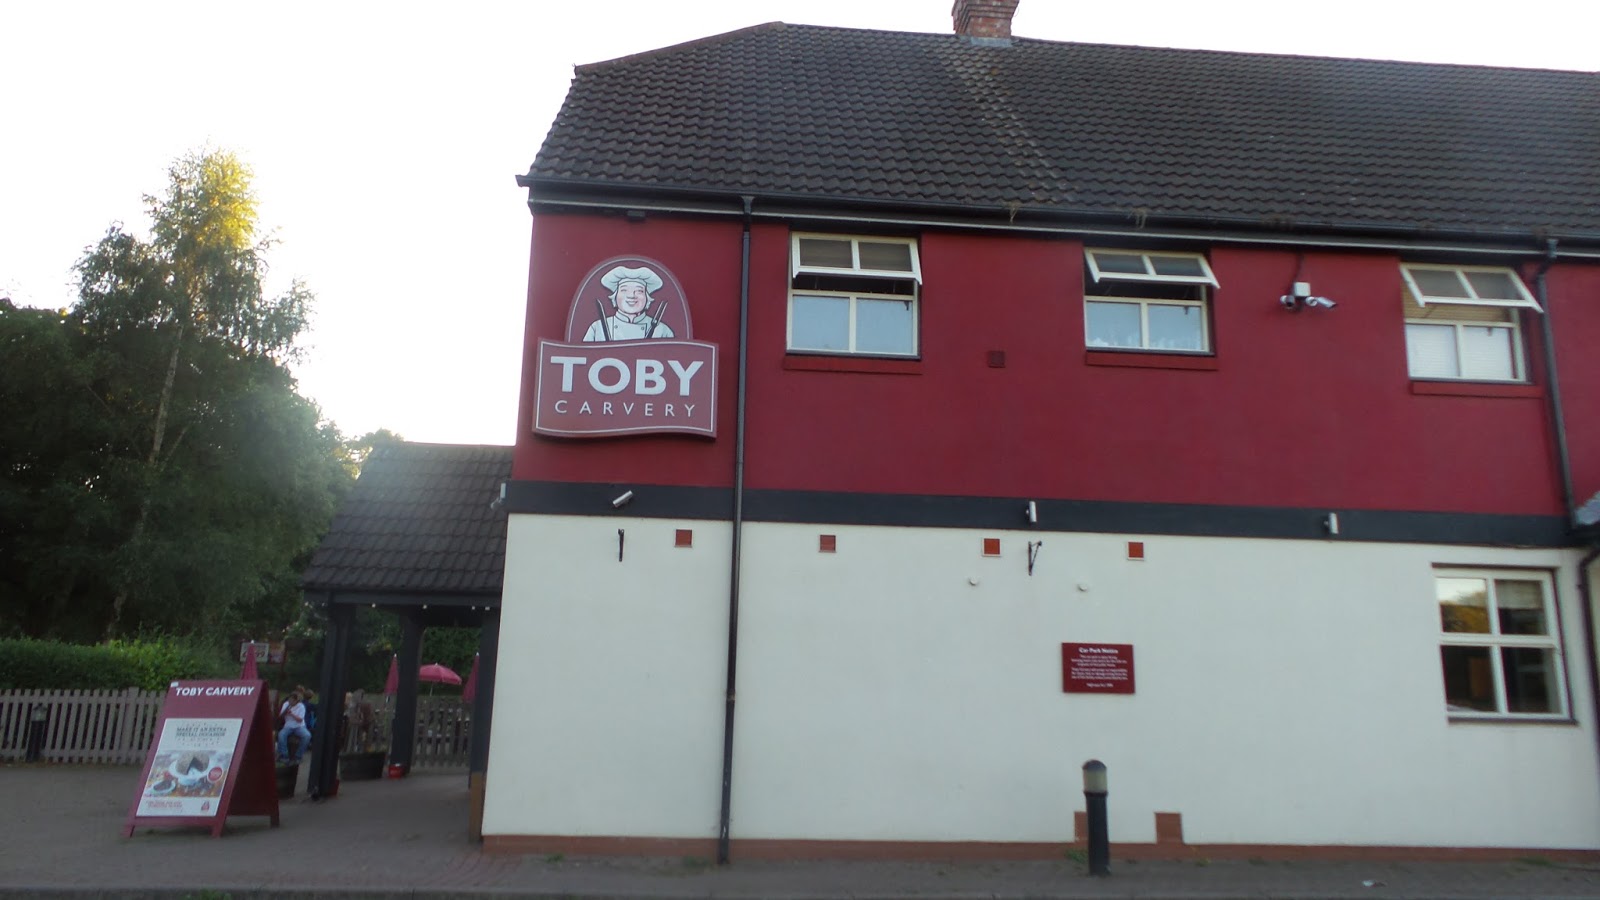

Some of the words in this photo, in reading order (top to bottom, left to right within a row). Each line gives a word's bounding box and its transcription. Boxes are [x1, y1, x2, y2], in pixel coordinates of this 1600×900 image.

[550, 356, 704, 396] TOBY
[555, 400, 695, 417] CARVERY
[176, 687, 204, 696] TOBY
[205, 686, 255, 696] CARVERY
